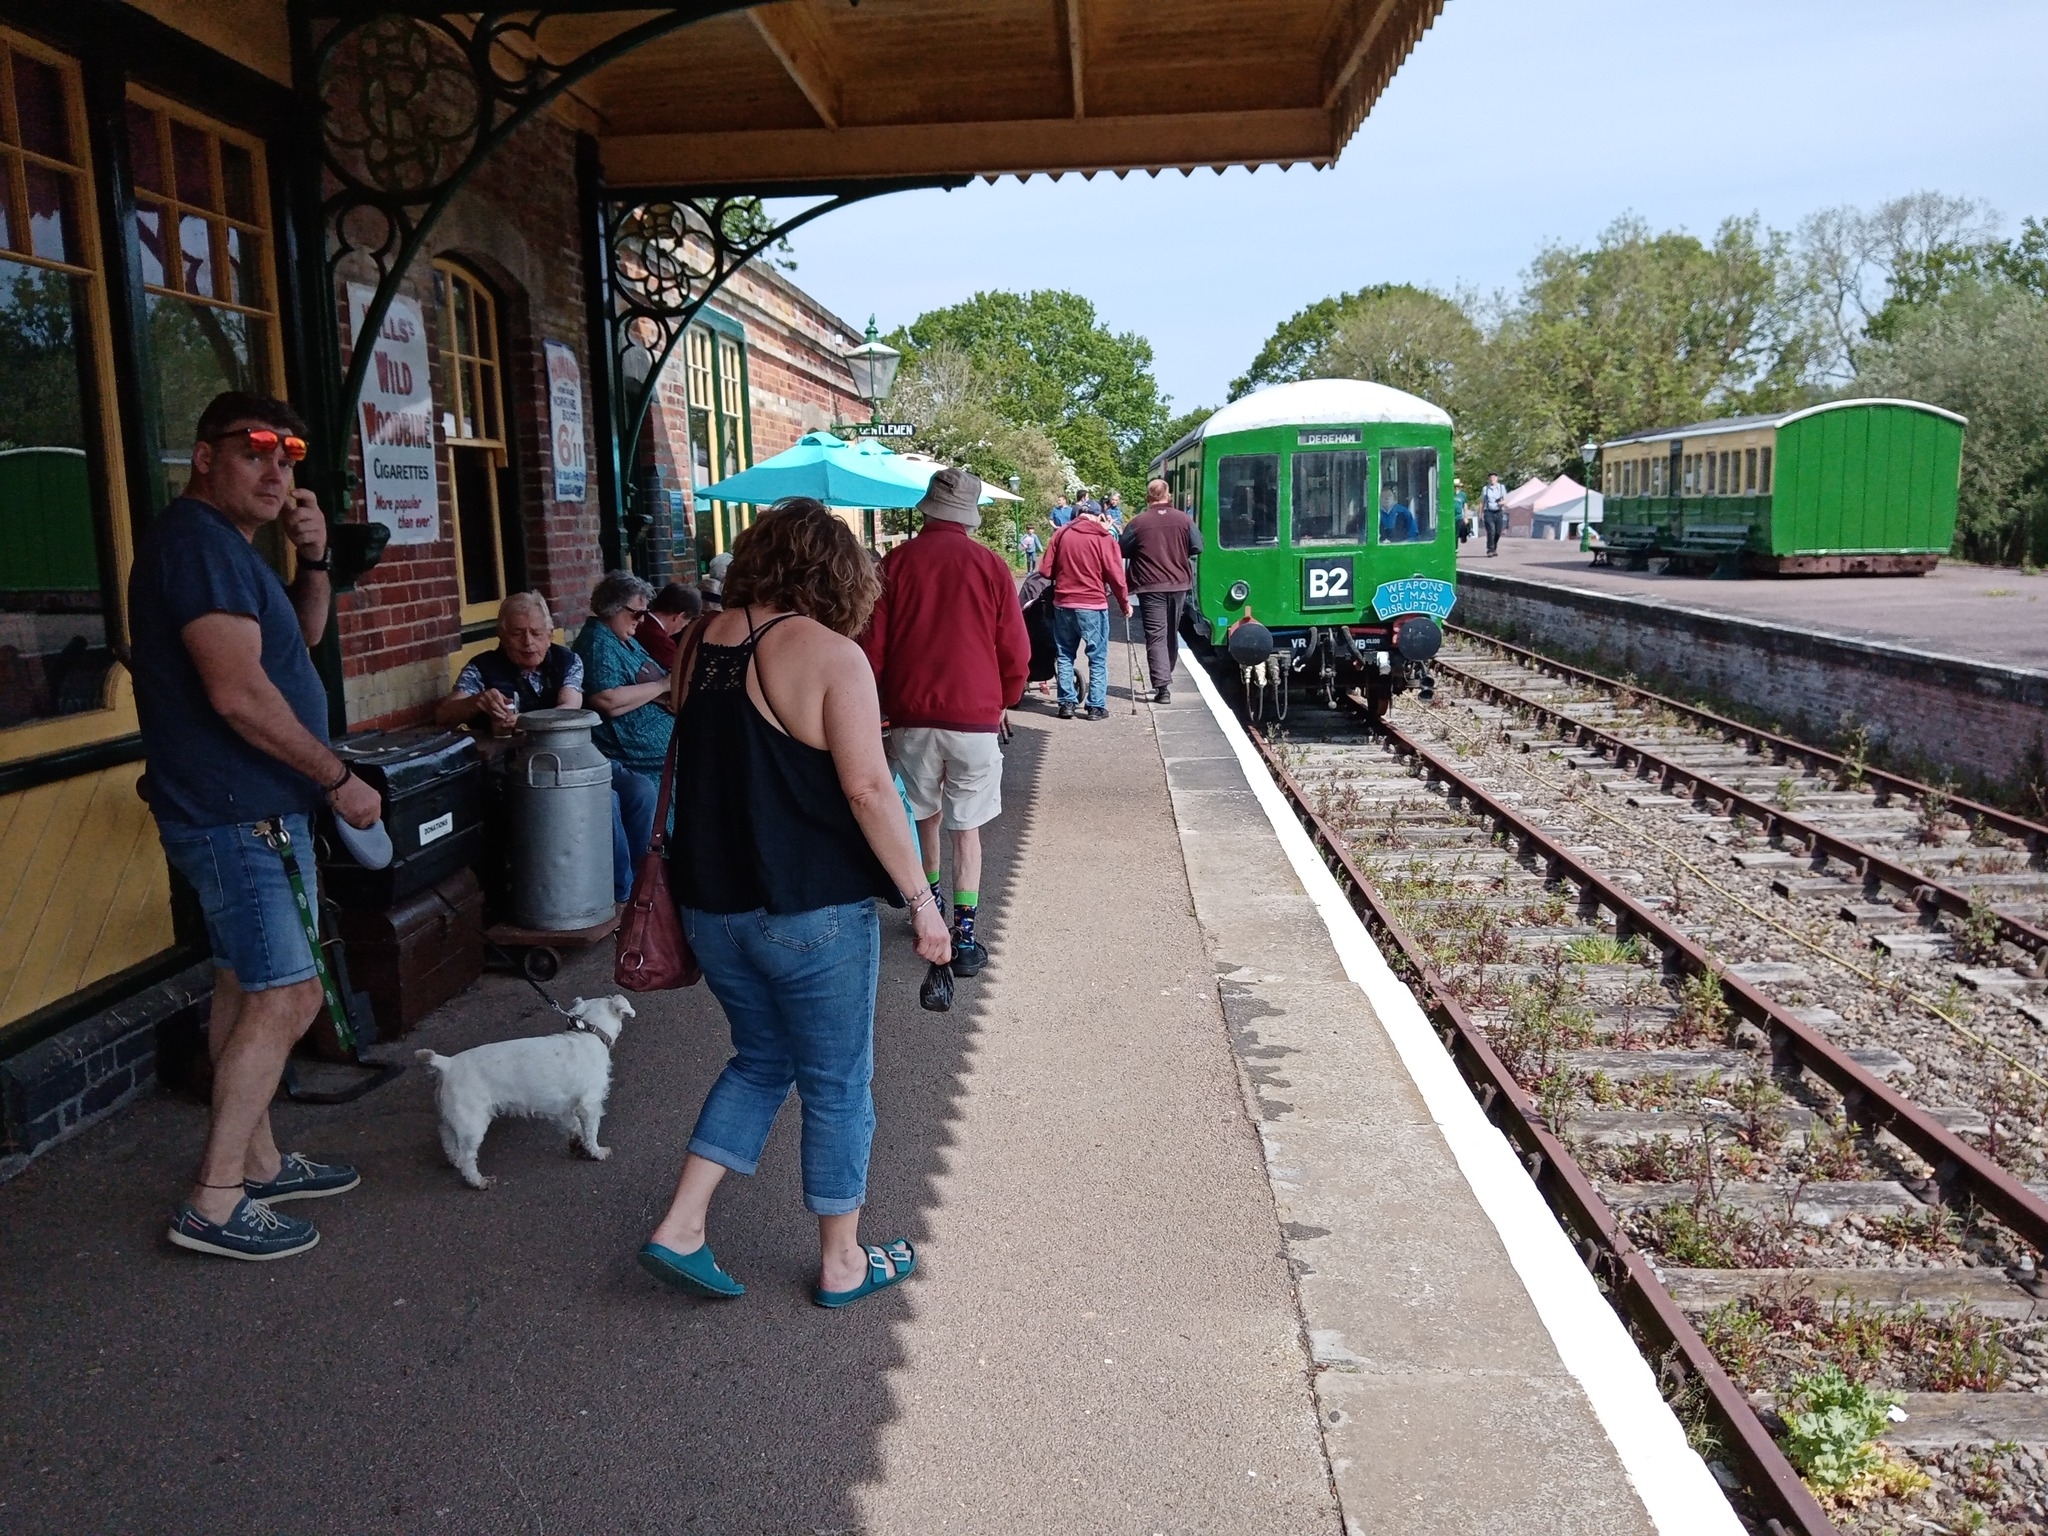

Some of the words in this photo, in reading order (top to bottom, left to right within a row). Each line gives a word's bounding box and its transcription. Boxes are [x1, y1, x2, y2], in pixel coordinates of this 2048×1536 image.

[375, 351, 413, 396] WILD
[362, 402, 432, 449] WOODBINE
[1308, 433, 1356, 444] DEREHAM
[374, 458, 429, 480] CIGARETTES
[395, 494, 421, 514] popular
[398, 515, 414, 529] than
[1309, 567, 1349, 598] B2
[1386, 581, 1444, 593] WEAPONS
[1389, 592, 1405, 603] OF
[1409, 591, 1439, 602] MASS
[1379, 602, 1448, 617] DISRUPTION
[1291, 638, 1307, 649] VR
